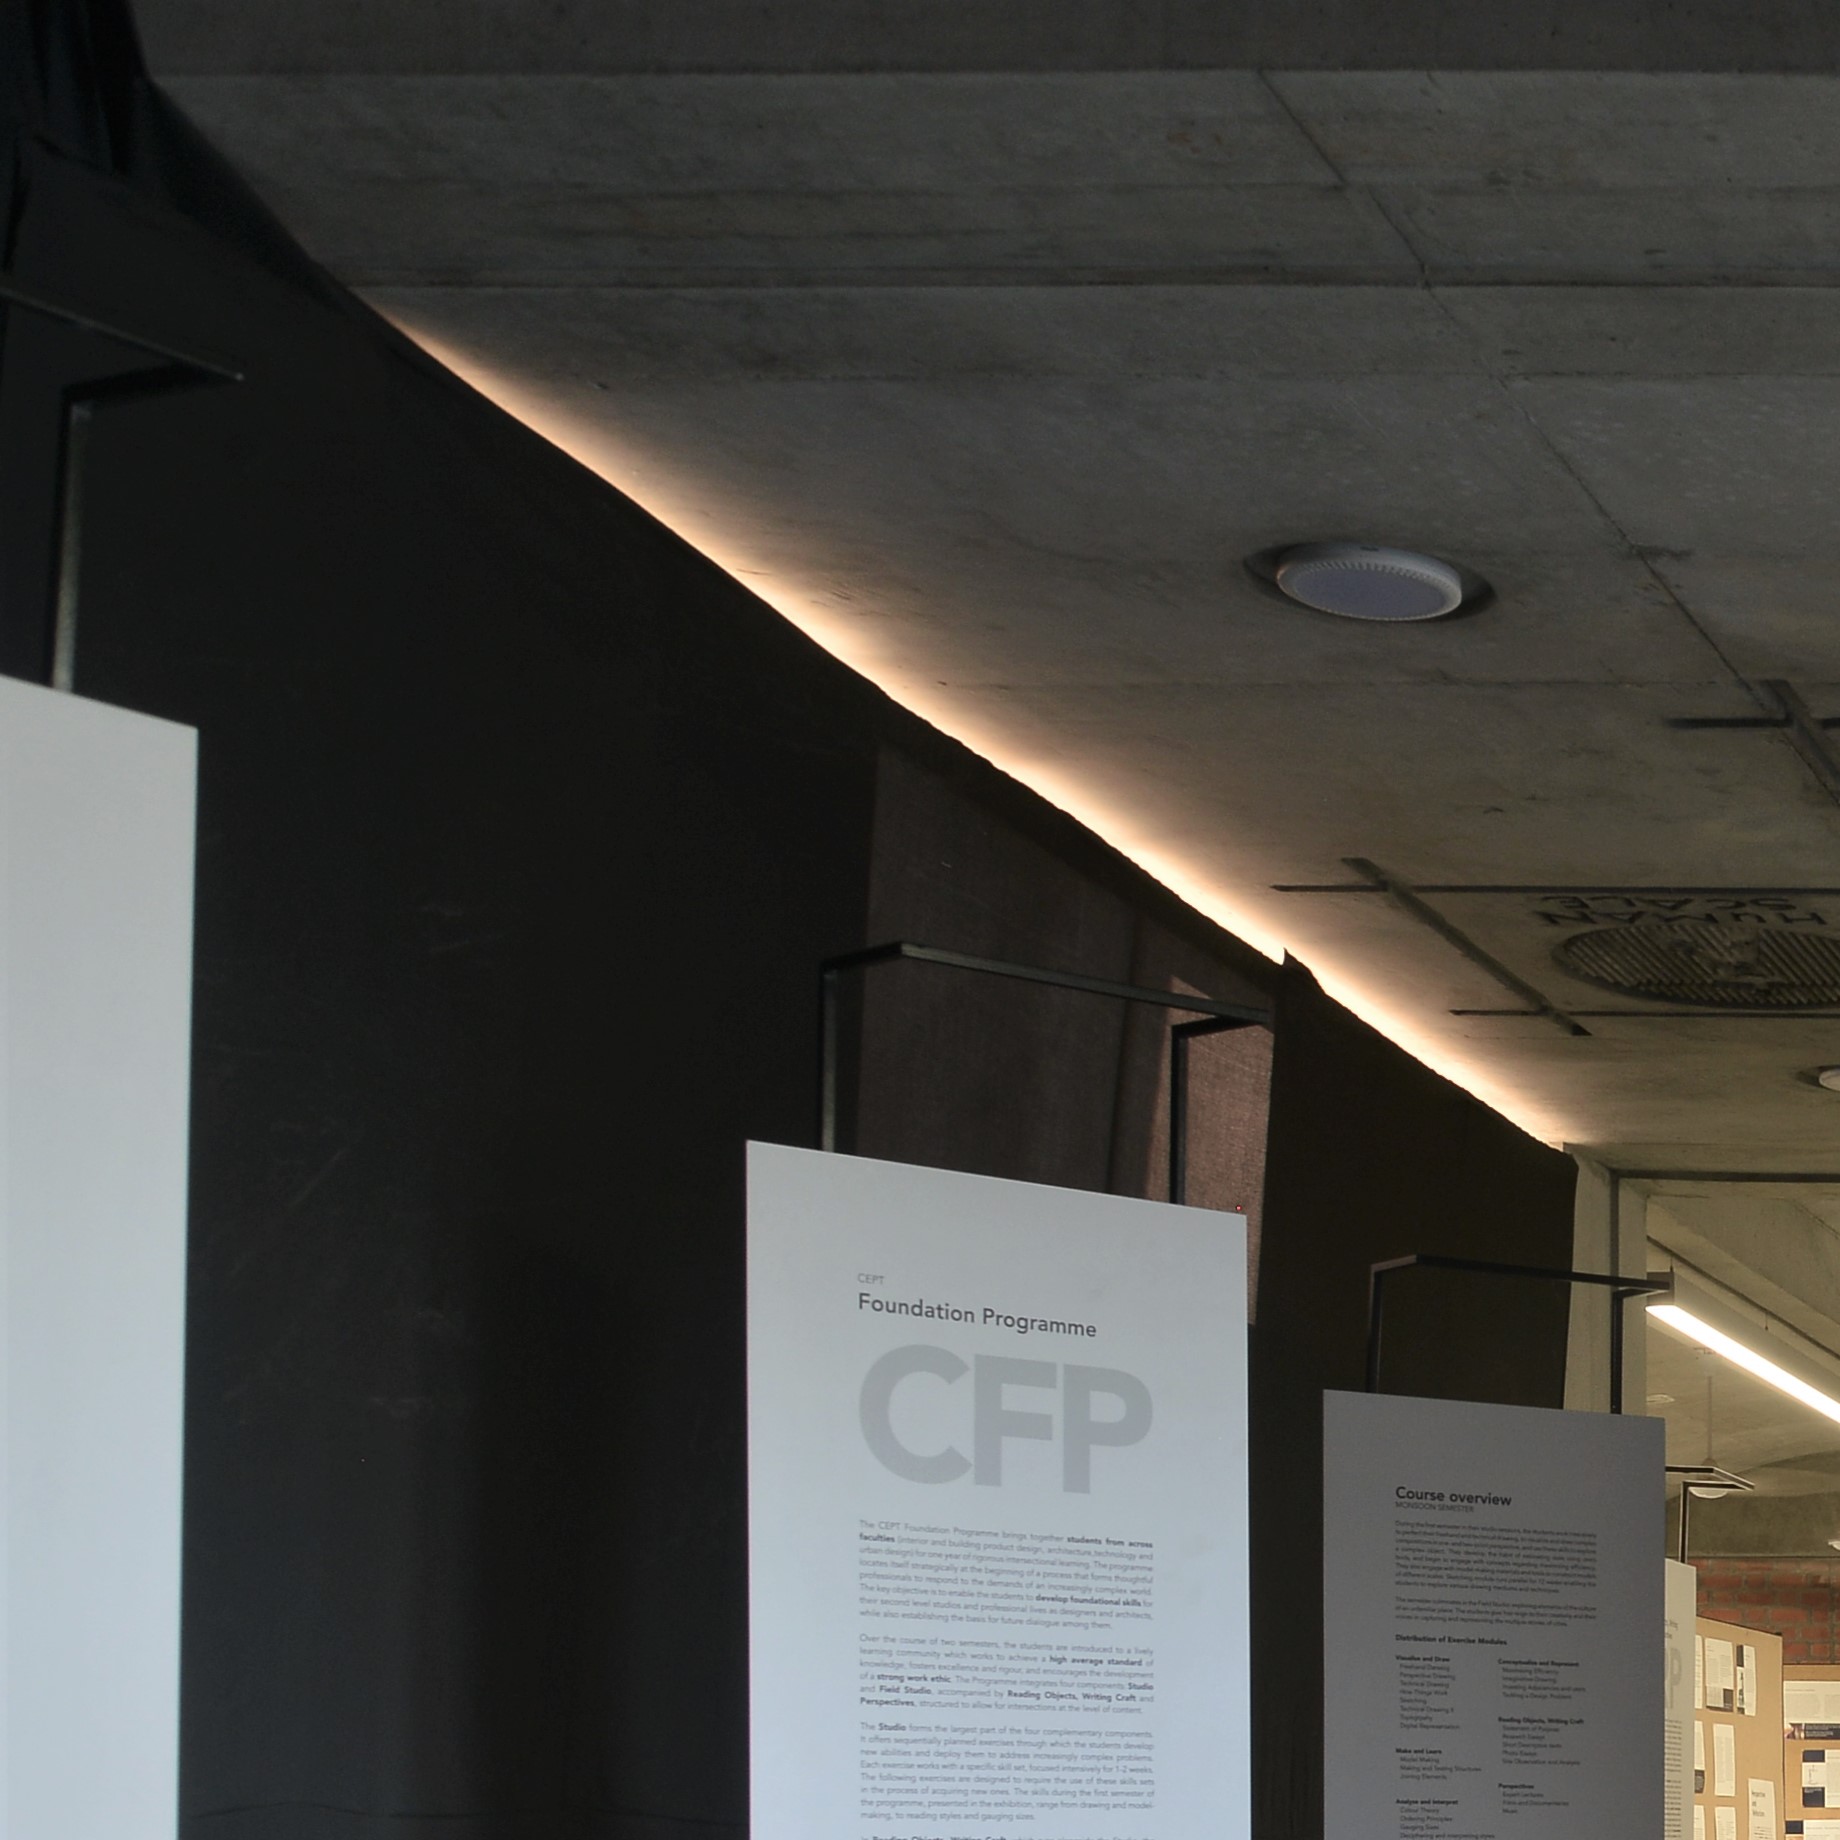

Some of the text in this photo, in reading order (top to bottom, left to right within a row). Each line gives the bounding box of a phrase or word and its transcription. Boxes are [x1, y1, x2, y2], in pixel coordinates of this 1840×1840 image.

[1539, 896, 1798, 911] SCALE
[1530, 910, 1828, 926] HUMAN
[857, 1273, 885, 1286] CEPT
[858, 1292, 1097, 1338] Foundation Programme
[859, 1343, 1154, 1495] CFP
[1395, 1486, 1511, 1506] Course overview
[1067, 1534, 1102, 1544] students
[1105, 1537, 1125, 1546] from
[1128, 1540, 1153, 1548] across
[991, 1591, 1023, 1600] students
[1035, 1593, 1068, 1604] develop
[1070, 1595, 1121, 1605] foundational
[1122, 1598, 1141, 1607] skills
[1049, 1655, 1067, 1664] high
[1071, 1657, 1103, 1666] average
[1107, 1657, 1142, 1666] standard
[876, 1672, 904, 1683] strong
[907, 1674, 928, 1682] work
[1127, 1682, 1154, 1690] Studio
[879, 1685, 900, 1693] Field
[1007, 1690, 1041, 1700] Reading
[1044, 1691, 1078, 1701] Objects,
[1082, 1692, 1112, 1702] Writing
[1115, 1694, 1136, 1702] Craft
[878, 1723, 906, 1731] Studio
